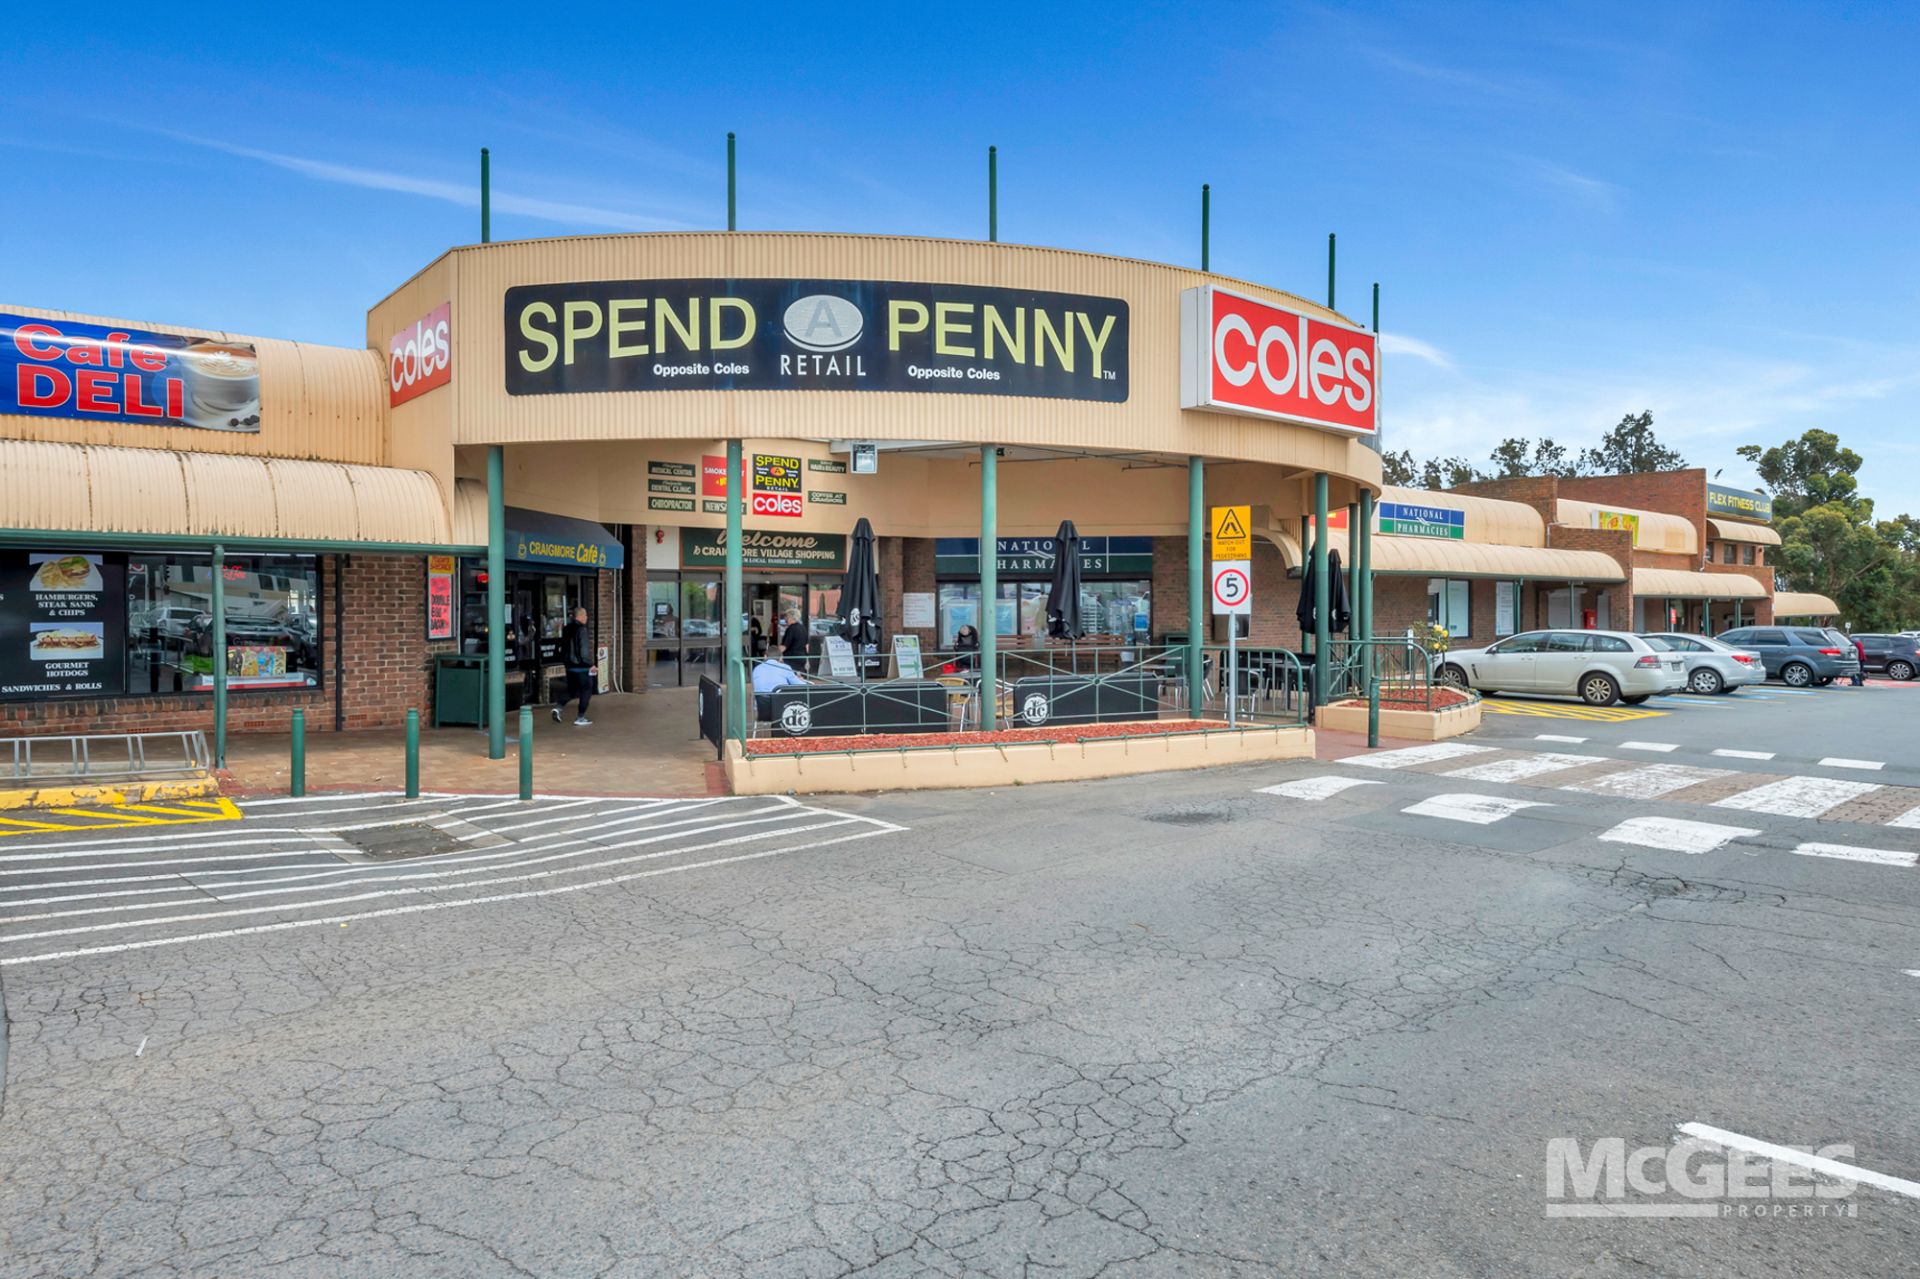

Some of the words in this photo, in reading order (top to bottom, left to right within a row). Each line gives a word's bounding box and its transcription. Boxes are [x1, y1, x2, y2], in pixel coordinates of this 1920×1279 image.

[518, 297, 757, 373] SPEND
[804, 299, 842, 338] A
[888, 299, 1117, 379] PENNY
[13, 323, 168, 372] Cafe
[391, 319, 449, 392] coles
[653, 363, 710, 377] Opposite
[714, 362, 750, 375] Coles
[780, 354, 866, 376] RETAIL
[1214, 313, 1372, 413] coles
[908, 364, 963, 380] Opposite
[967, 367, 1000, 381] Coles
[16, 363, 184, 419] DELI
[755, 455, 799, 469] SPEND
[755, 474, 799, 488] PENNY
[651, 499, 693, 510] CHIROPRACTOR
[753, 494, 802, 513] coles
[1709, 491, 1727, 506] FLEX
[1728, 495, 1755, 510] FITNESS
[1755, 501, 1771, 513] CLUB
[1402, 507, 1444, 520] NATIONAL
[1397, 523, 1449, 536] PHARMACIES
[529, 541, 575, 559] CRAIGMORE
[702, 546, 758, 557] CRAIORE
[760, 548, 793, 559] VILLAGE
[795, 549, 836, 560] SHOPPING
[997, 540, 1090, 551] NATIOL
[997, 558, 1103, 569] HARMAES
[1226, 577, 1239, 598] 5
[46, 669, 89, 677] HOTDOGS
[1, 683, 61, 693] SANDWICHES
[65, 683, 72, 691] &
[75, 682, 103, 690] ROLLS
